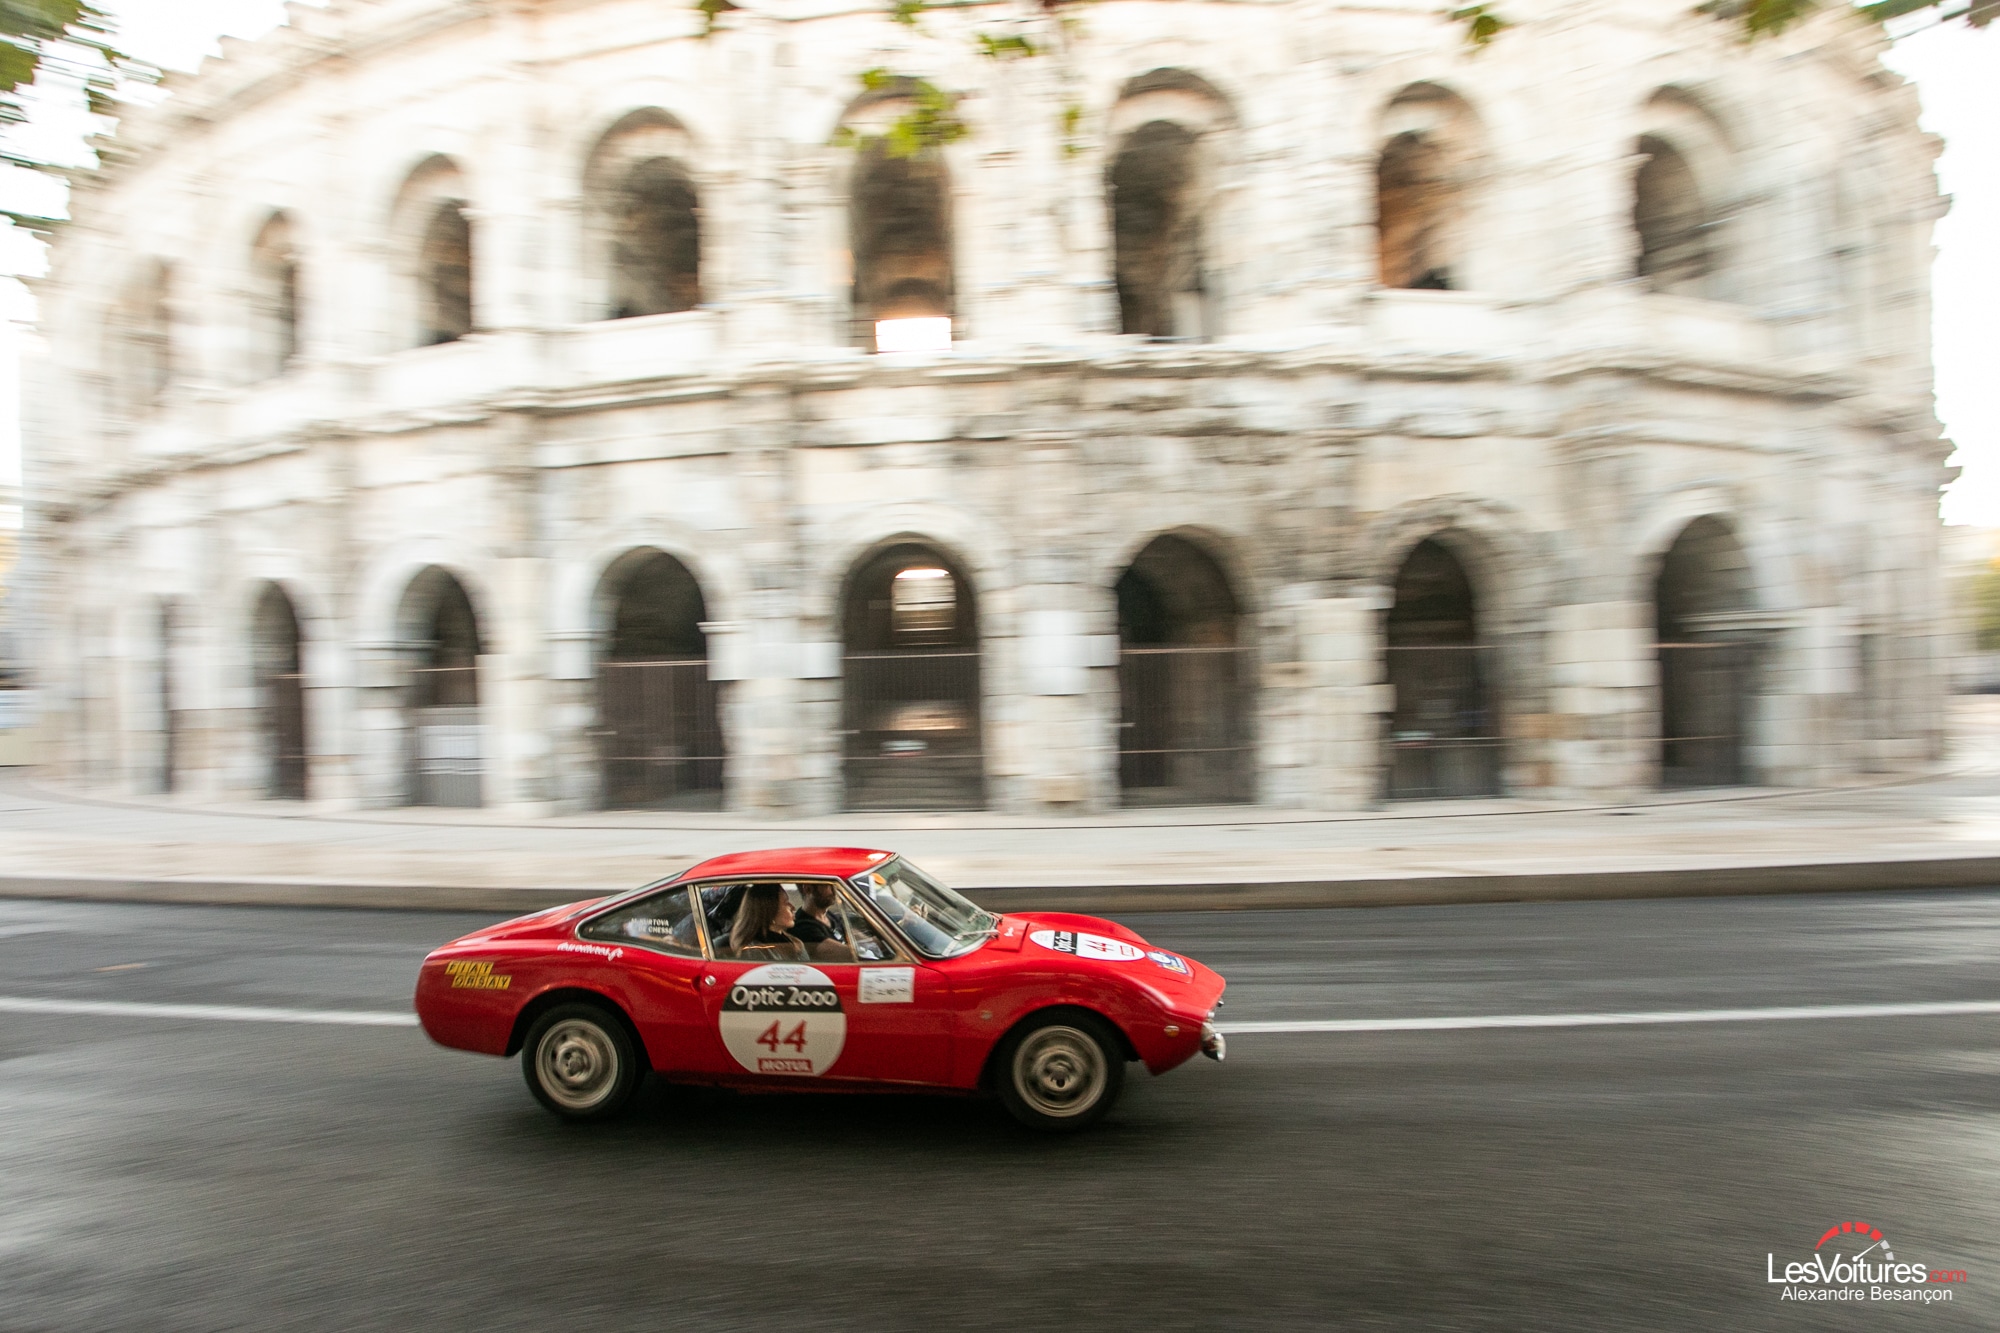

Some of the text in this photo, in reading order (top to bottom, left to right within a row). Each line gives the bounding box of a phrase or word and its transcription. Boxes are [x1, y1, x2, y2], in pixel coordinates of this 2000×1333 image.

[447, 961, 491, 973] FIAT
[453, 975, 510, 988] ORSAY
[731, 985, 838, 1011] Optic 2000
[755, 1019, 807, 1053] 44
